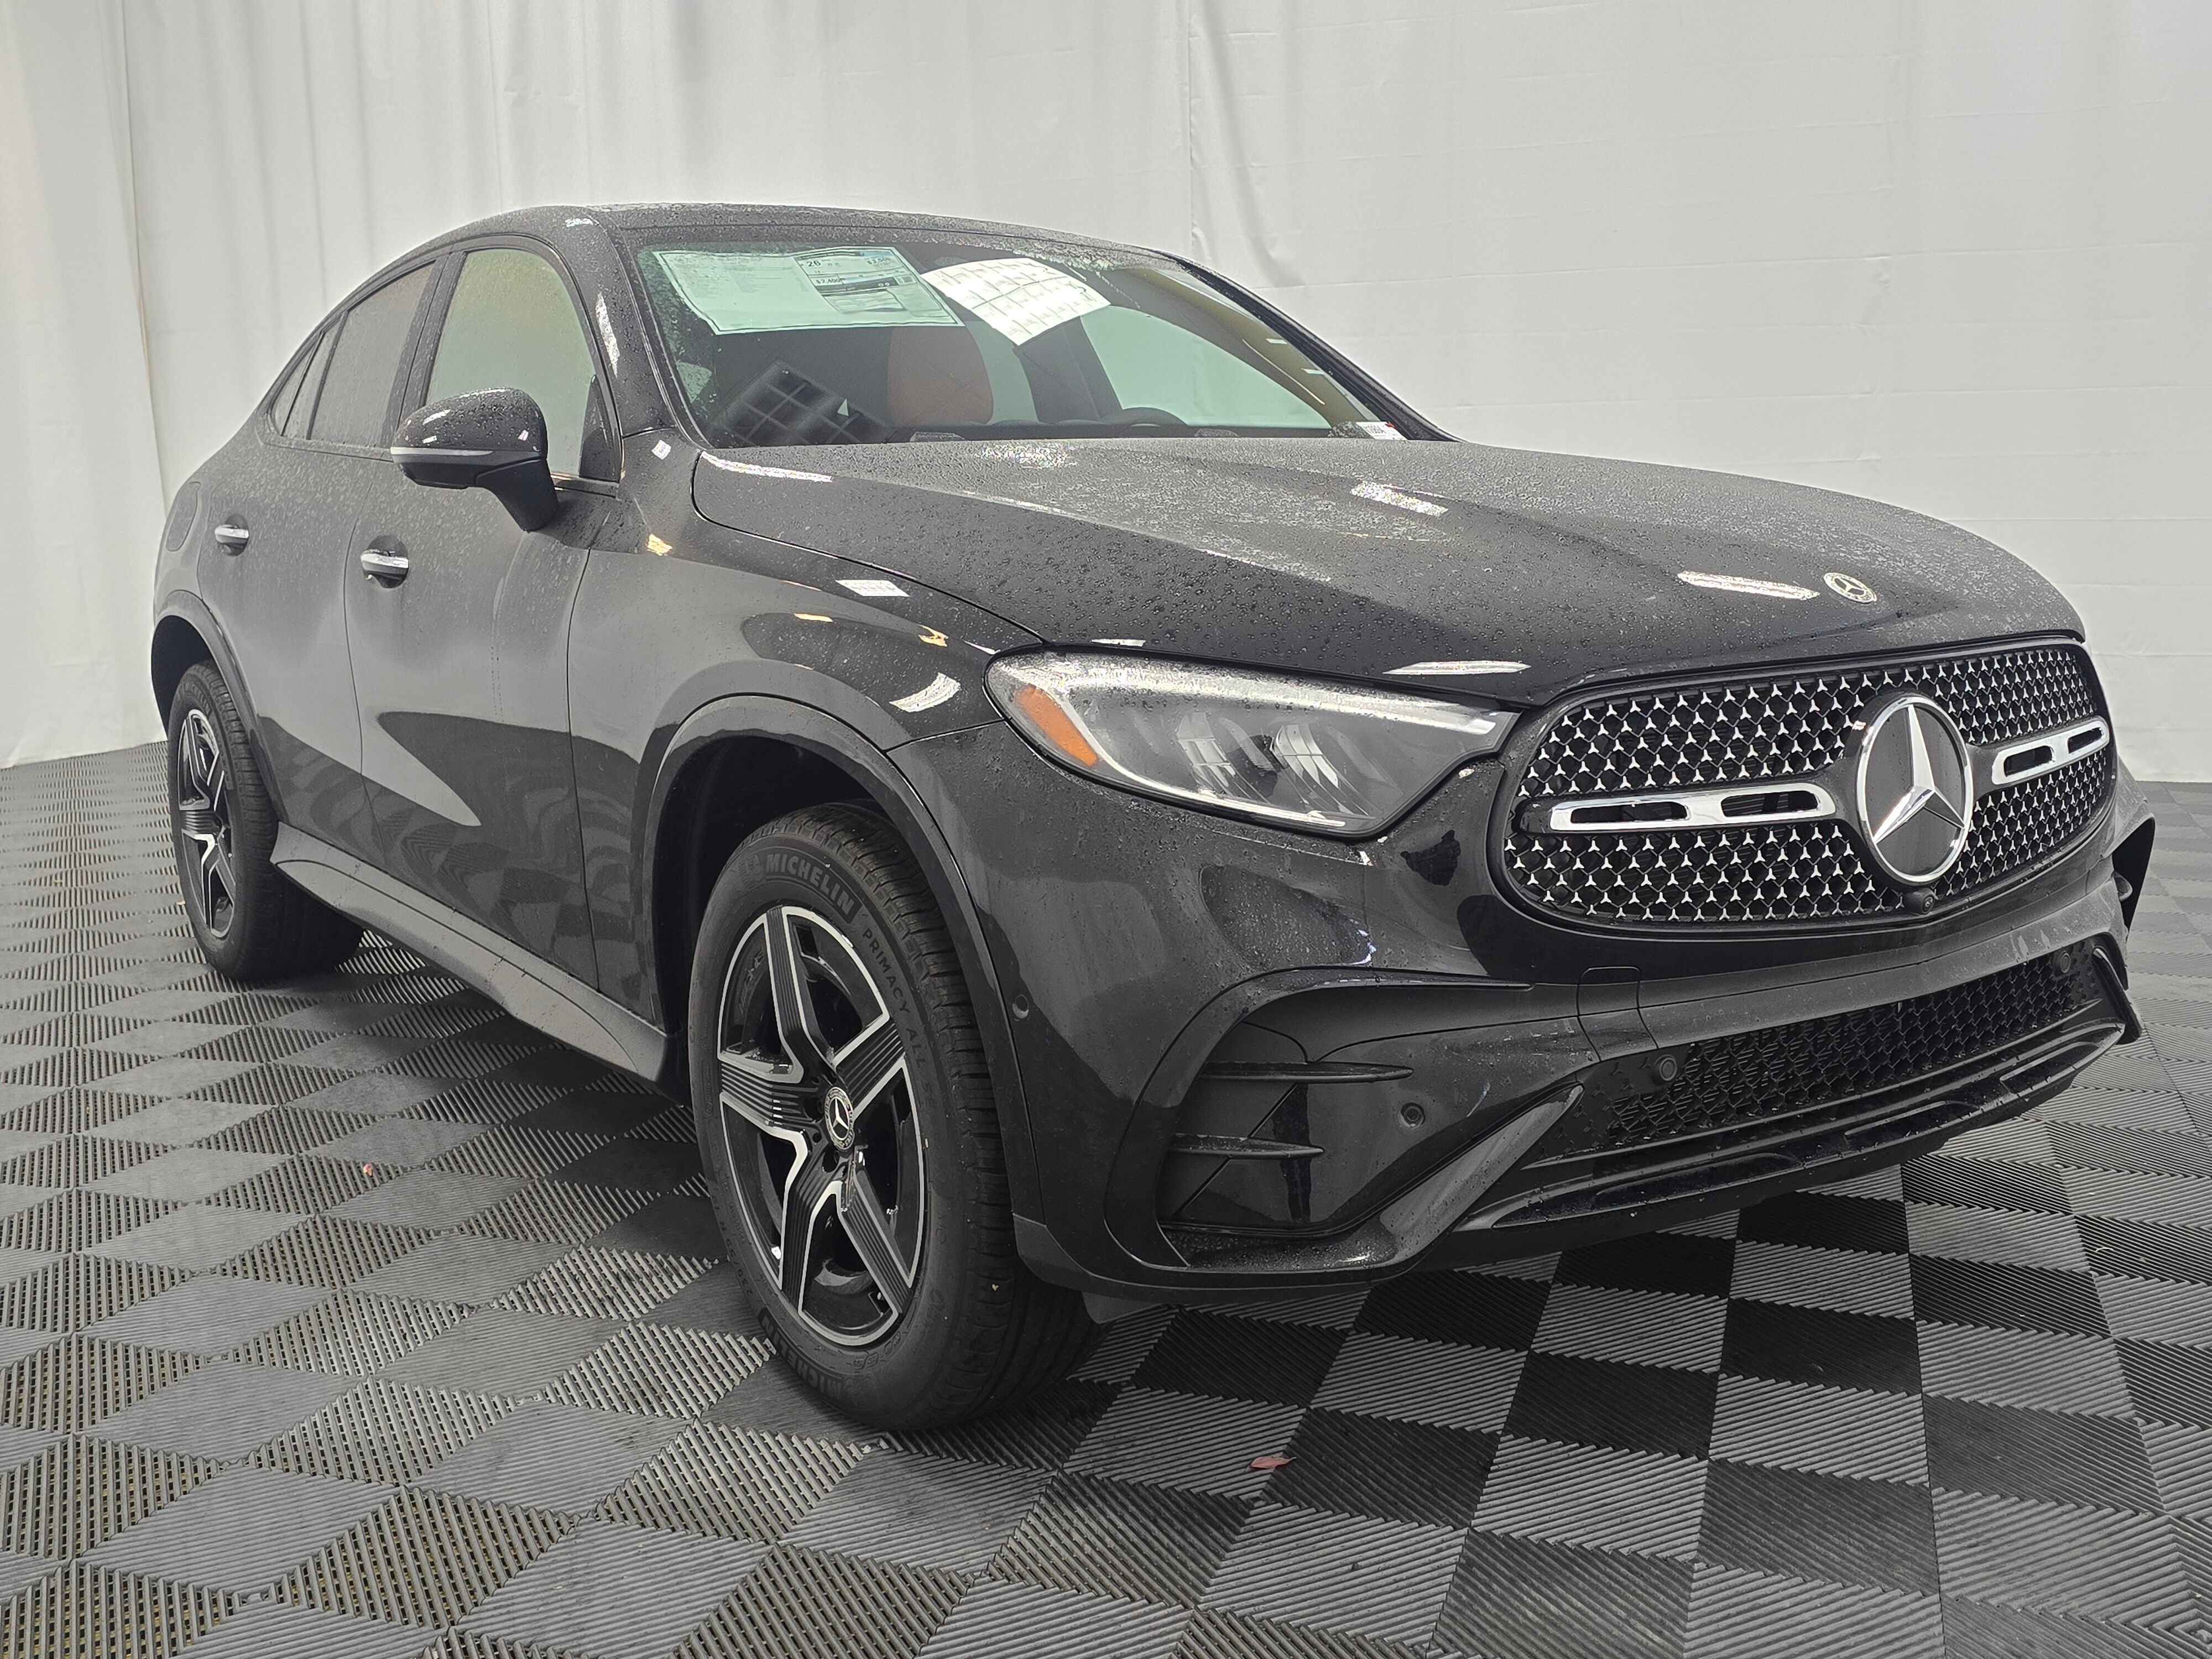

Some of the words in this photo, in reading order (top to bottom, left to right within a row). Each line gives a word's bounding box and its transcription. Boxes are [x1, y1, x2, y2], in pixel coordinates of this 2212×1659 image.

[765, 854, 854, 915] MICHELIN
[863, 930, 910, 1015] PRIMACY
[906, 1027, 925, 1066] ALL
[768, 1323, 842, 1399] MICHELIN
